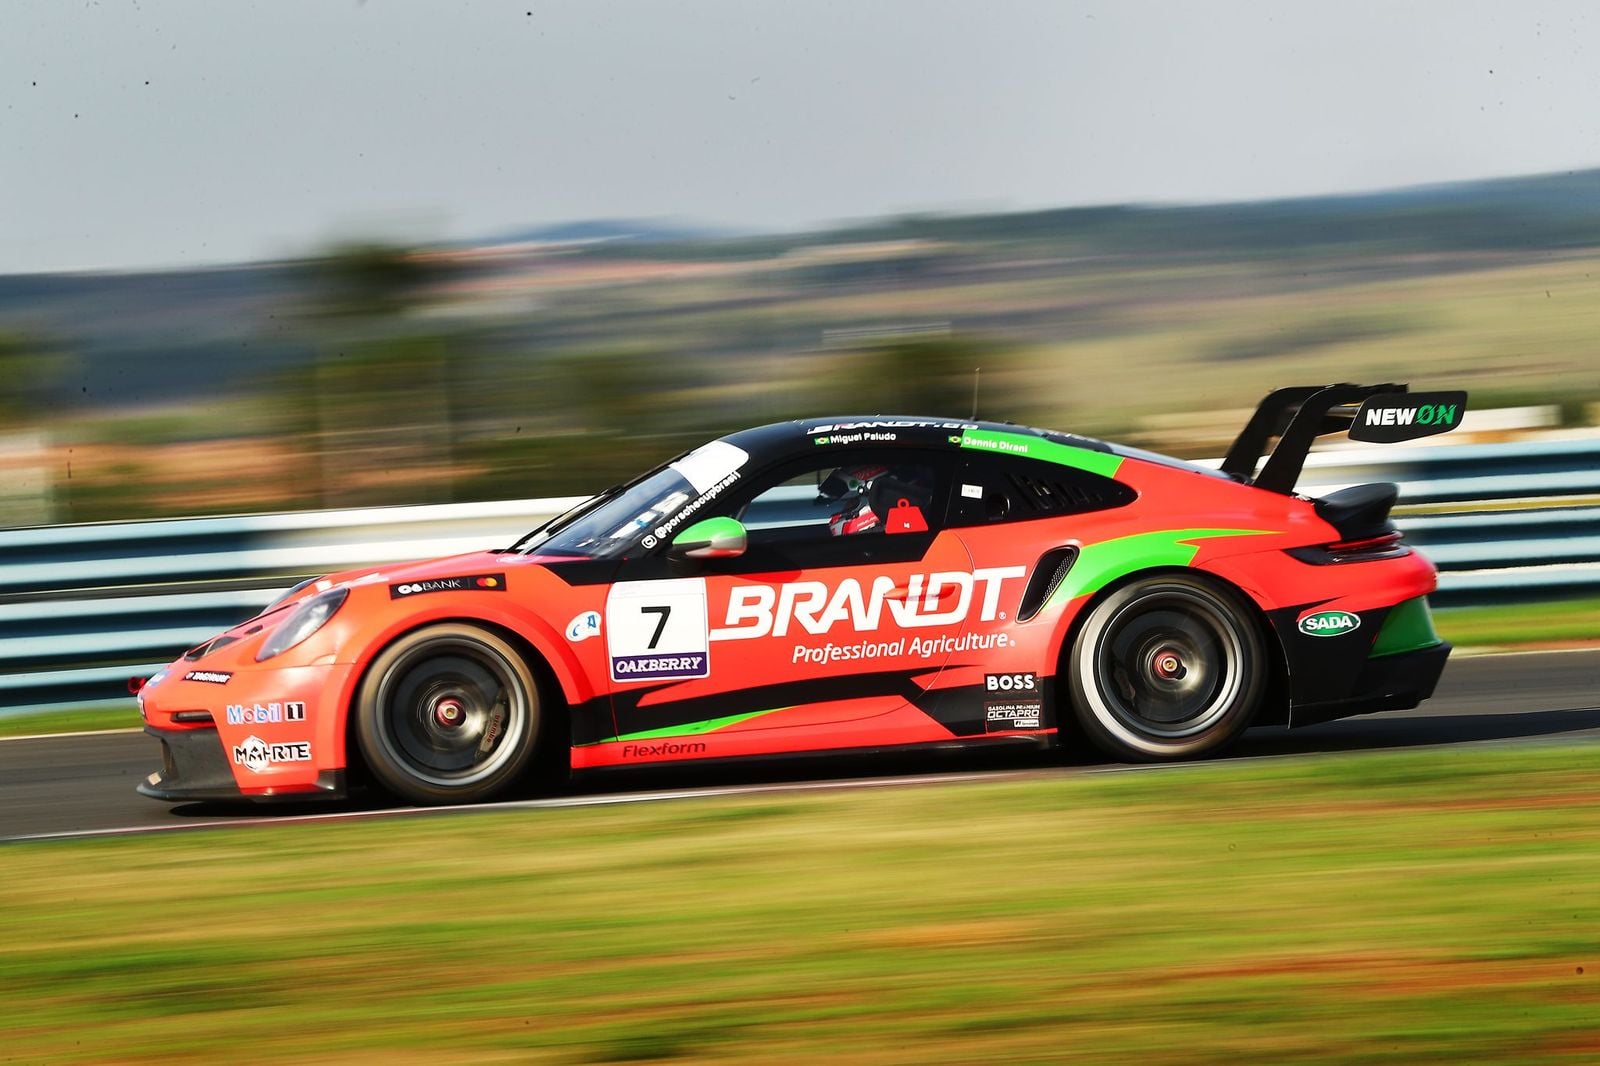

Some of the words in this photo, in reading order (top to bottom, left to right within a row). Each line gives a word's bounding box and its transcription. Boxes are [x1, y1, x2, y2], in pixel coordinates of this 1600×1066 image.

[830, 433, 862, 444] Miguel
[864, 432, 896, 441] Paludo
[999, 441, 1028, 453] Dirani
[709, 566, 1026, 641] BRANDT
[641, 606, 671, 649] 7
[1306, 616, 1353, 630] SADA
[792, 637, 905, 664] Professional
[616, 657, 702, 673] OAKBERRY
[987, 675, 1035, 690] BOSS
[227, 700, 281, 723] Mobil
[987, 710, 1040, 719] OCTAPRO
[623, 742, 706, 757] Flexform
